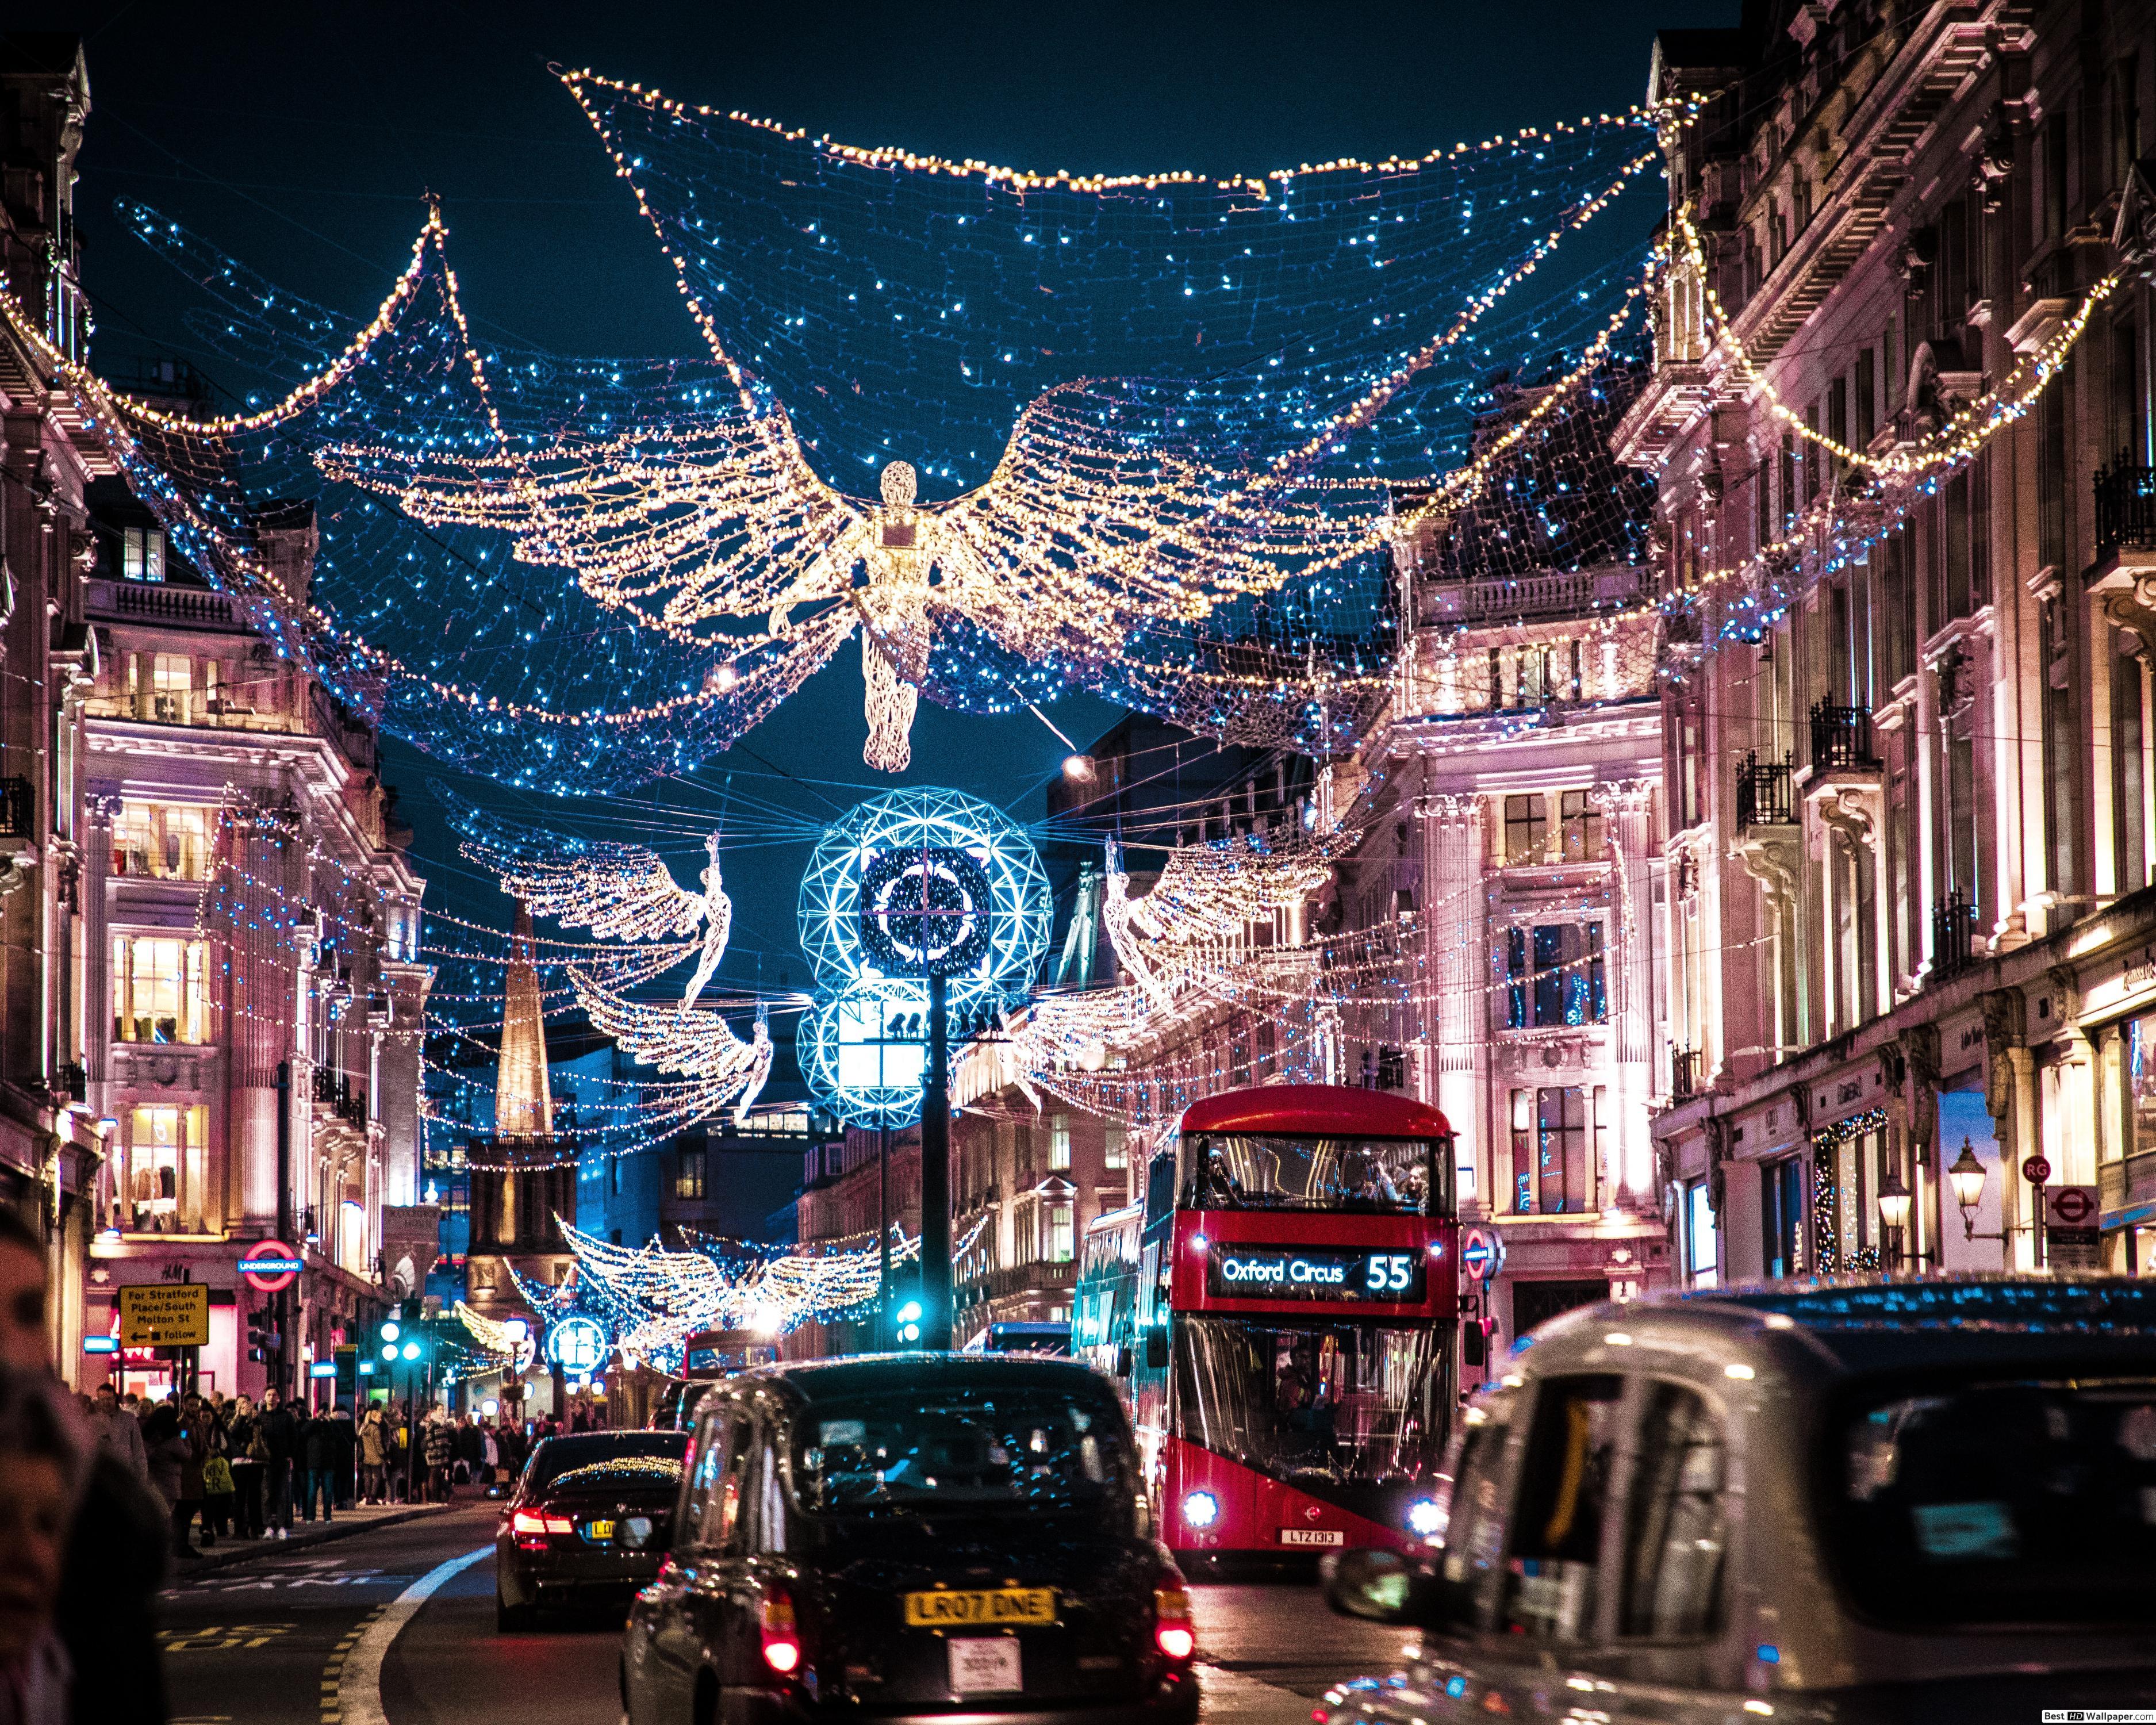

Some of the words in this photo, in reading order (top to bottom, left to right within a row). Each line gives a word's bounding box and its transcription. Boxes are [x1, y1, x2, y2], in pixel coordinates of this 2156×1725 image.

[2027, 1164, 2047, 1176] RG
[1223, 1259, 1284, 1282] Oxford
[1290, 1260, 1344, 1283] Circus
[1367, 1255, 1410, 1290] 55
[128, 1292, 145, 1300] For
[149, 1290, 199, 1300] Stratford
[131, 1302, 197, 1312] Place/South
[137, 1315, 174, 1324] Molton
[178, 1313, 190, 1322] St
[164, 1330, 196, 1339] follow
[916, 1594, 983, 1619] LR07
